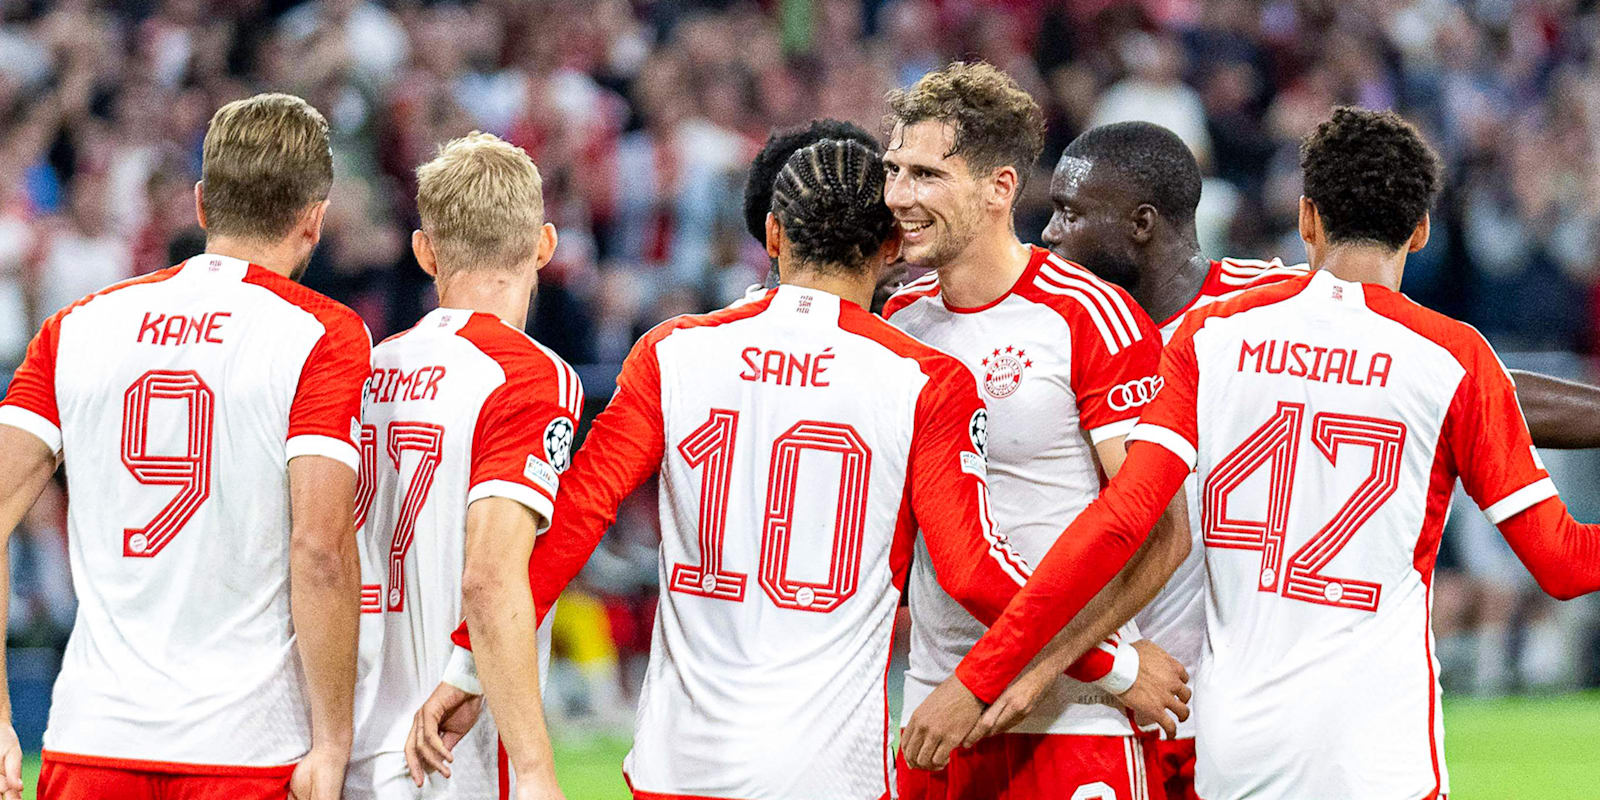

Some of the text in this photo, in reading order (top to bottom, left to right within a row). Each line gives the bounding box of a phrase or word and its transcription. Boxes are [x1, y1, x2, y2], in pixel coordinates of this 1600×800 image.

[137, 312, 232, 346] KANE
[739, 347, 836, 387] SANÉ
[1237, 339, 1393, 387] MUSIALA
[121, 369, 215, 558] 9
[669, 407, 873, 614] 10
[1201, 401, 1407, 613] 42
